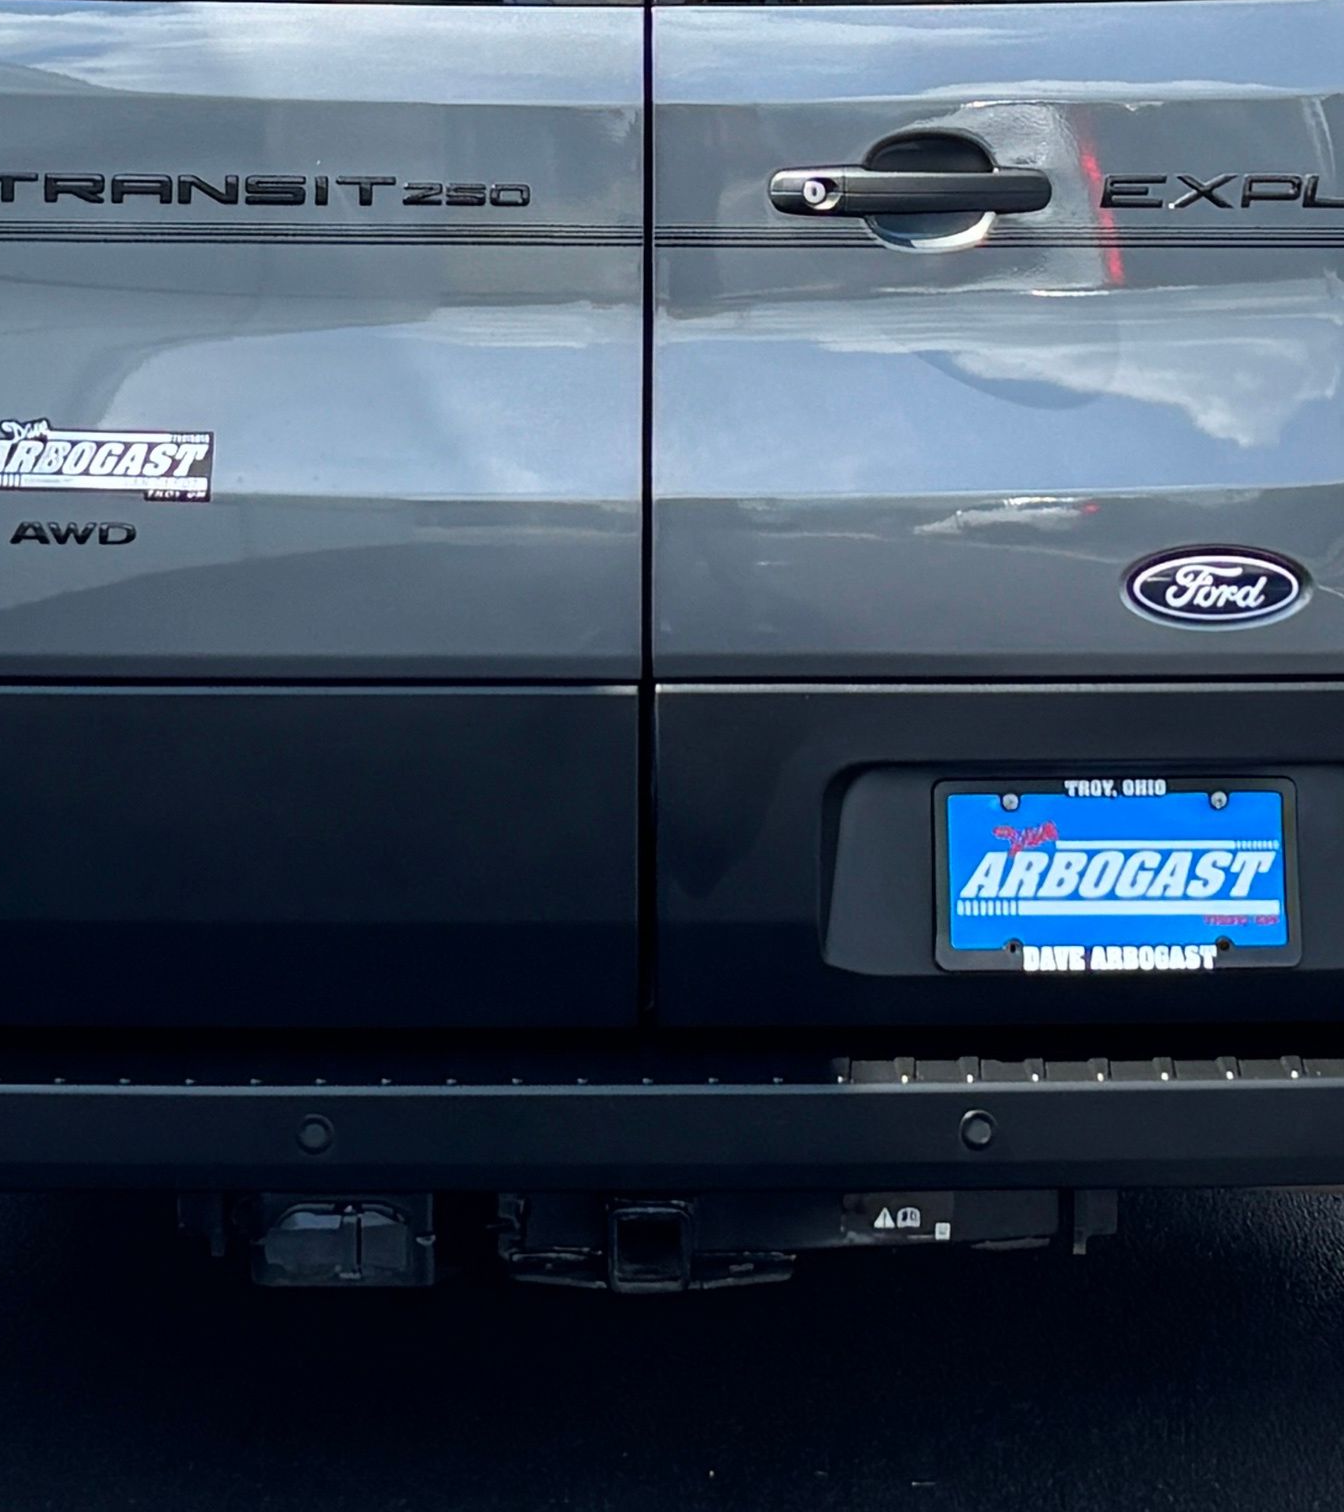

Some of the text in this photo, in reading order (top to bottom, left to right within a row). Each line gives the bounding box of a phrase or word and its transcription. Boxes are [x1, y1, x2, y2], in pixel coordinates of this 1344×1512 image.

[403, 183, 532, 207] 250
[9, 521, 137, 545] AWD
[1165, 564, 1268, 607] Ford
[1064, 779, 1167, 798] TROY, OHIO
[959, 850, 1276, 898] ARBOGAST
[1023, 945, 1218, 972] DAVE ARBOGAST
